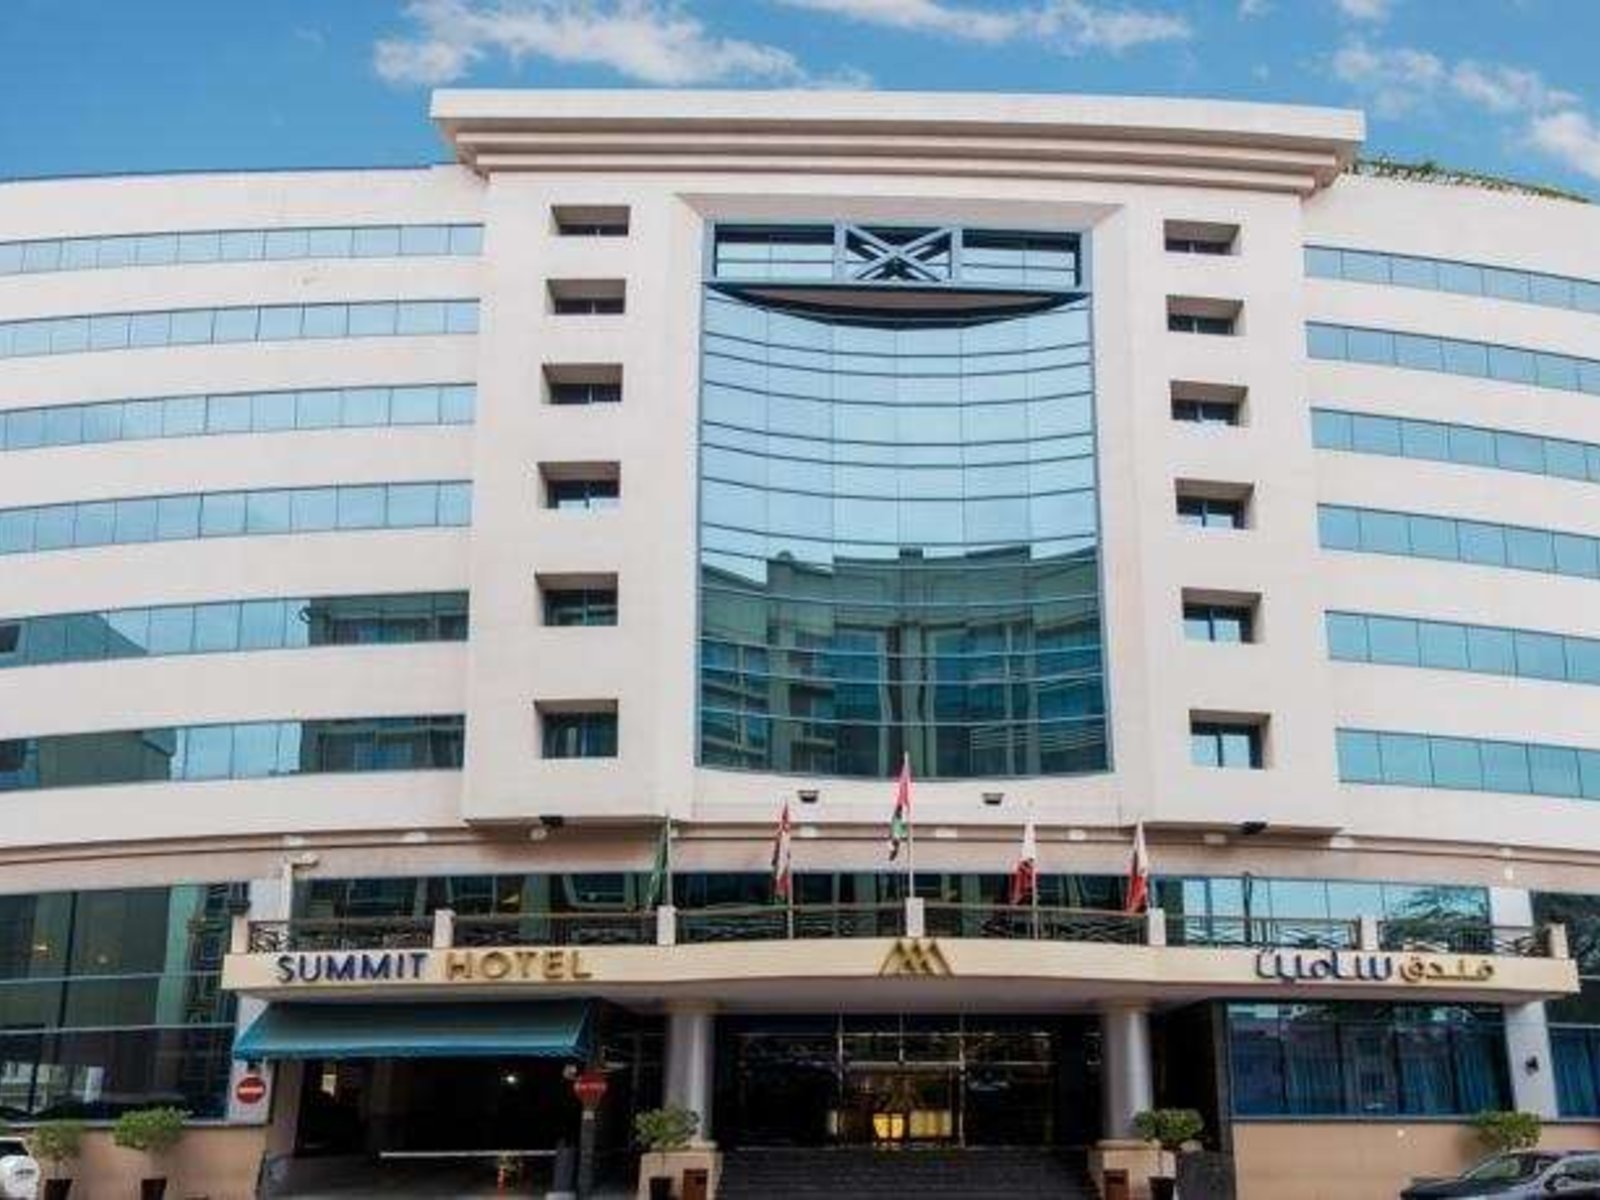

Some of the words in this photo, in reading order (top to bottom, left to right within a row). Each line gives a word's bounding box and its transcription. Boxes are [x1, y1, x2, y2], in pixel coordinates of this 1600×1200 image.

[277, 953, 427, 983] SUMMIT
[446, 950, 593, 980] HOTEL
[1400, 955, 1495, 983] فندق
